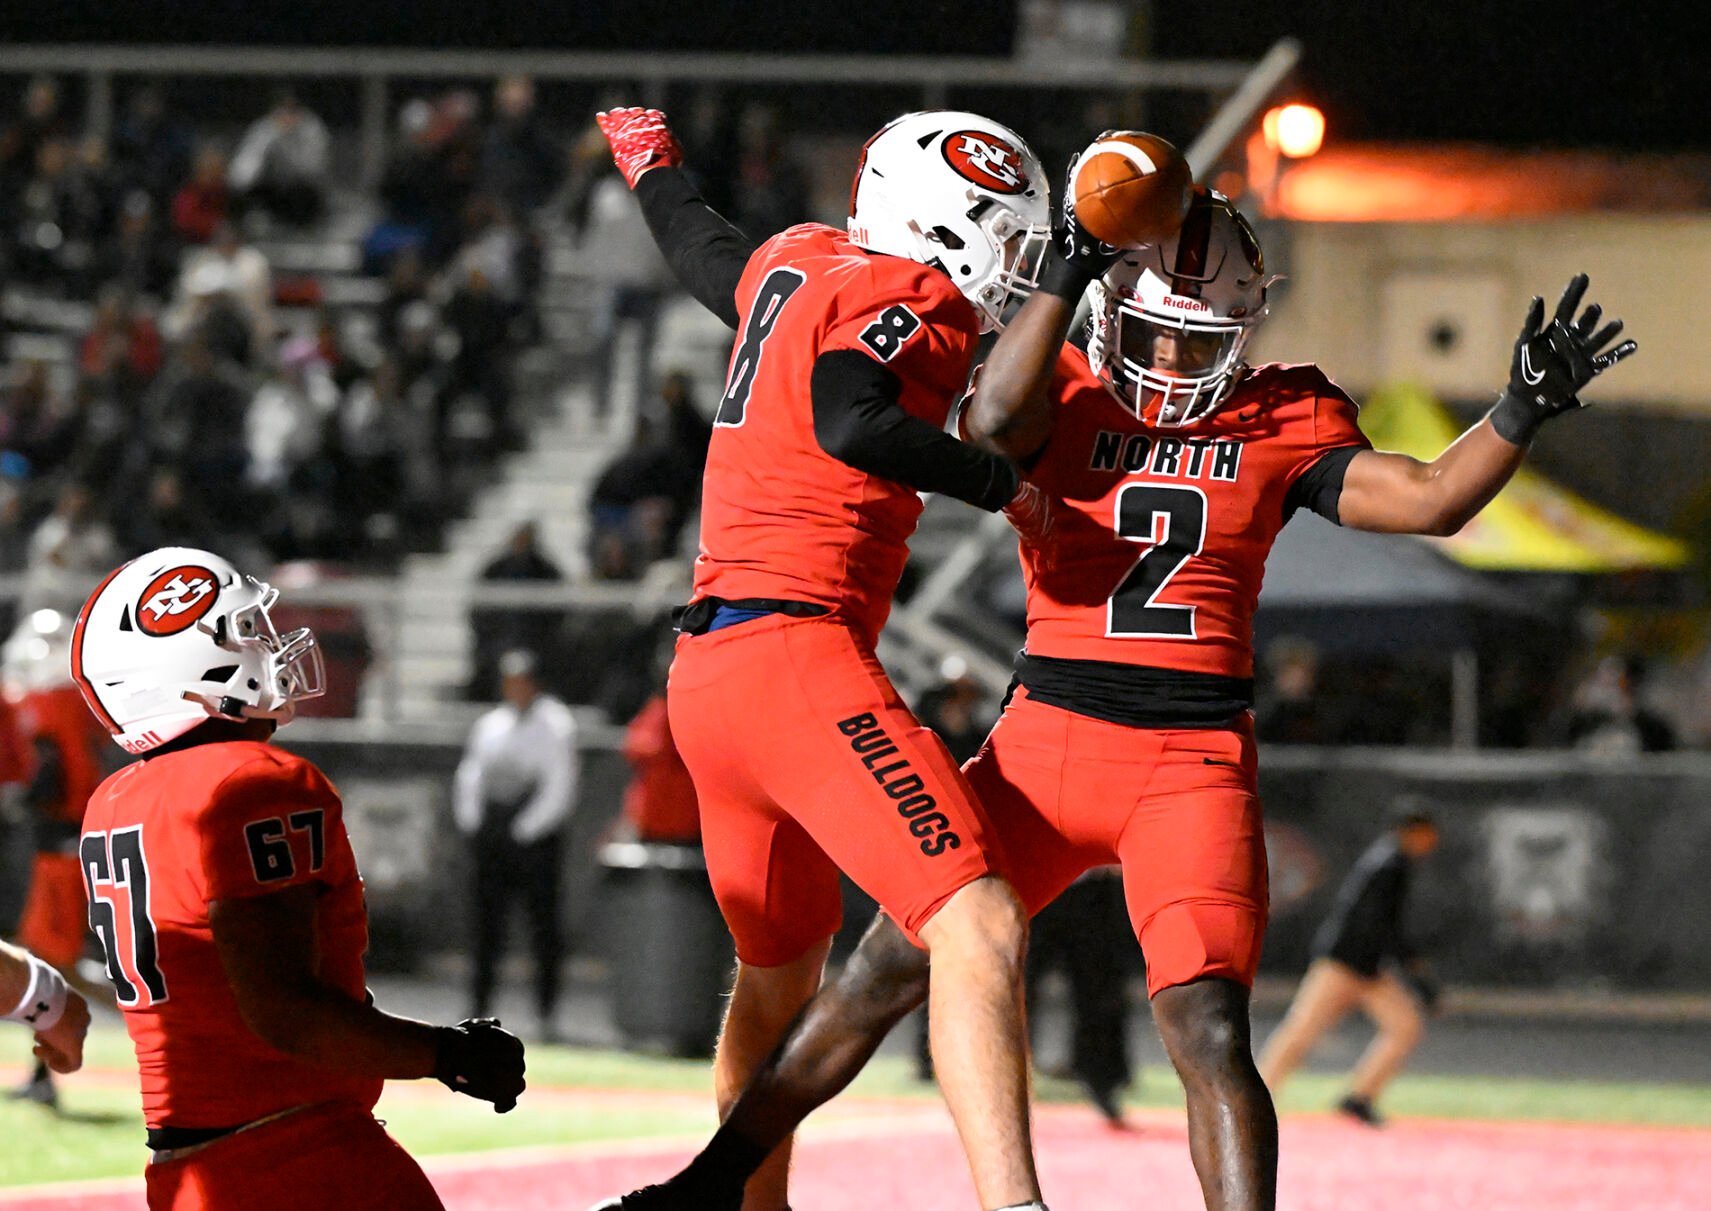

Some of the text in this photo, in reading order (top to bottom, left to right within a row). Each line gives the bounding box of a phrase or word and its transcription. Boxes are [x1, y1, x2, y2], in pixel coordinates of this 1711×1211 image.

[713, 266, 807, 428] 8
[858, 303, 921, 363] 8
[1163, 296, 1208, 312] Riddell
[1090, 432, 1244, 482] NORTH
[1104, 481, 1208, 640] 2
[837, 712, 961, 857] BULLDOGS
[243, 808, 325, 885] 67
[79, 823, 169, 1007] 67
